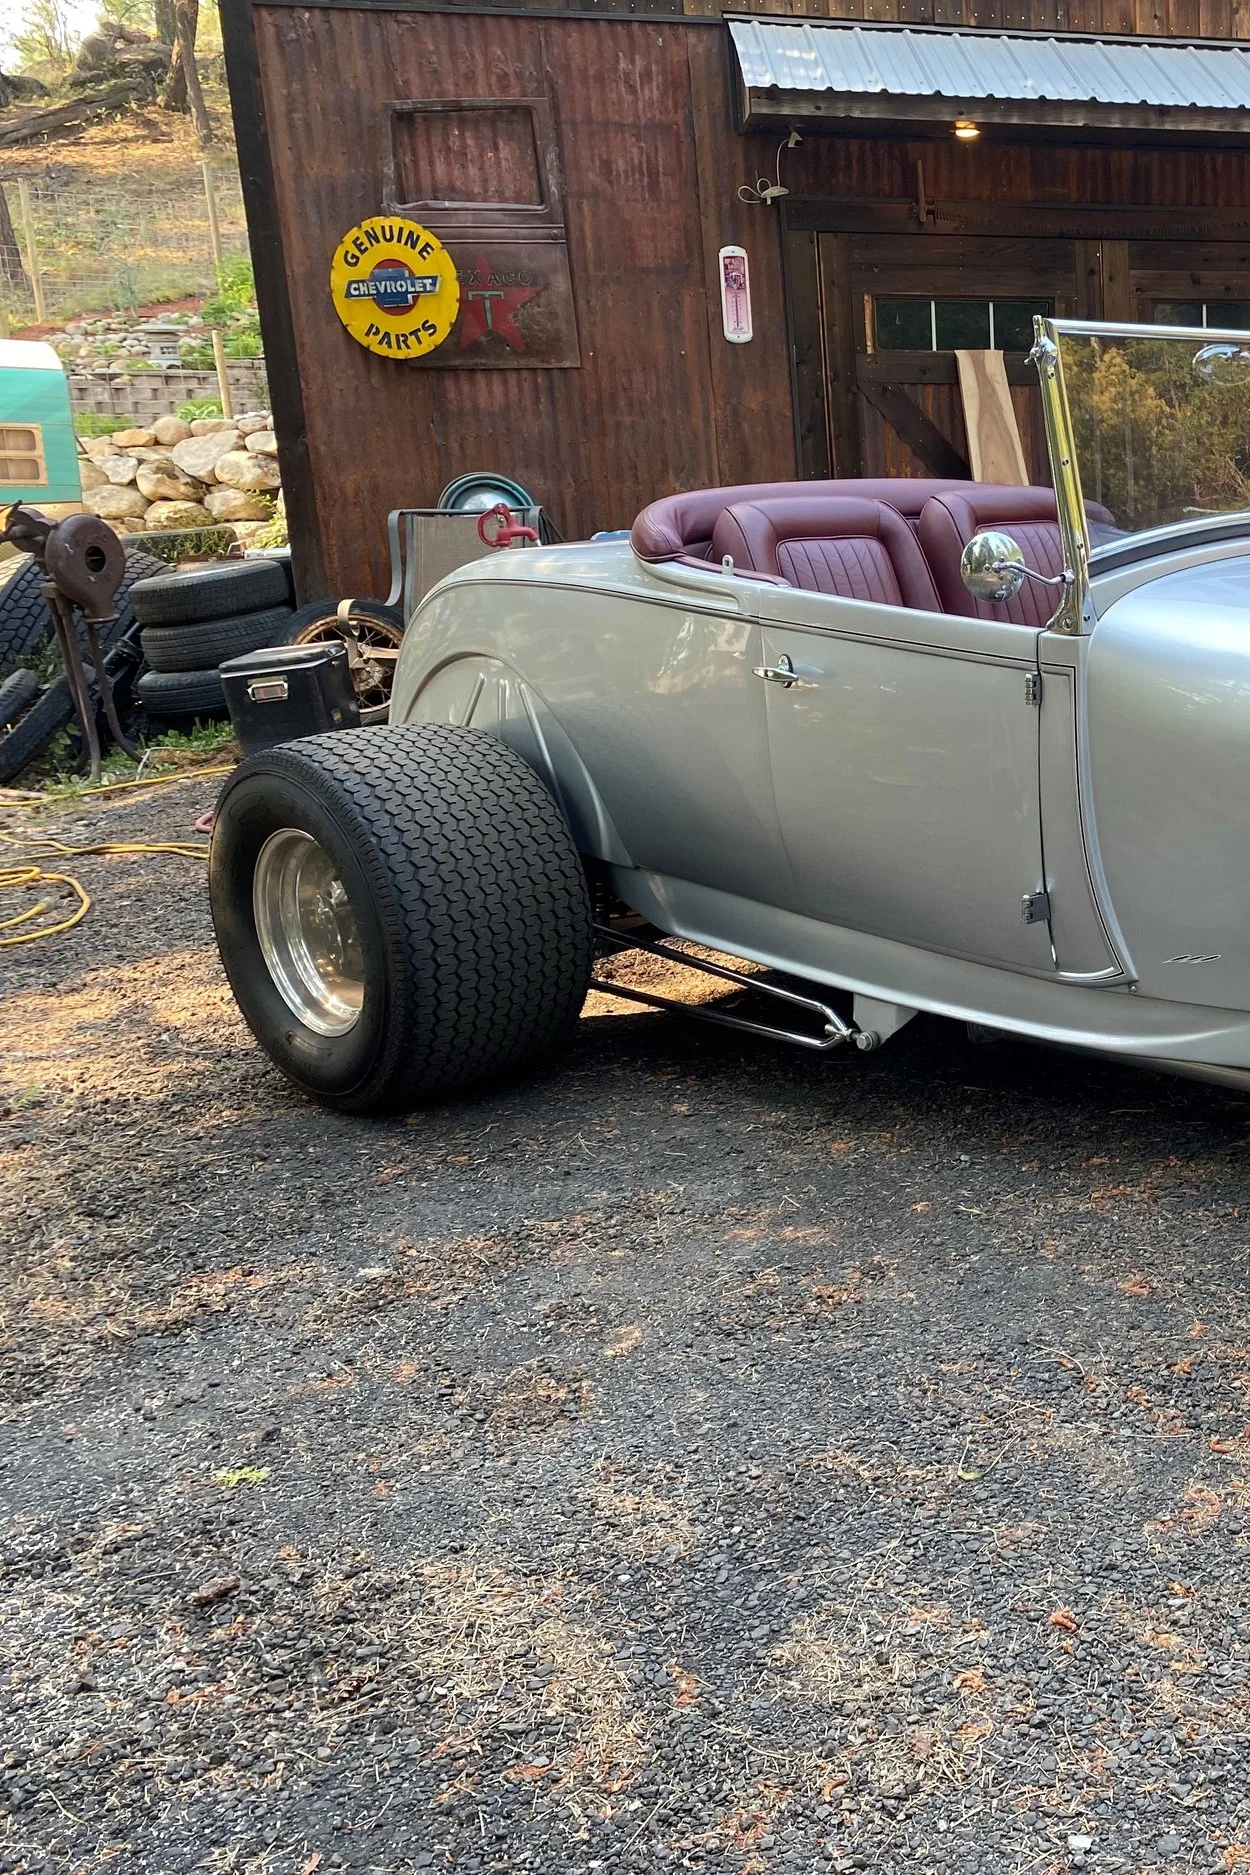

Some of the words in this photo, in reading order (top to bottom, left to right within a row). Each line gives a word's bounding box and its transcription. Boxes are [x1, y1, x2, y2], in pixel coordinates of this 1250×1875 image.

[343, 224, 435, 268] GENUINE
[349, 279, 433, 296] CHEVROLET
[457, 269, 532, 286] EXACO
[364, 319, 438, 351] PARTS
